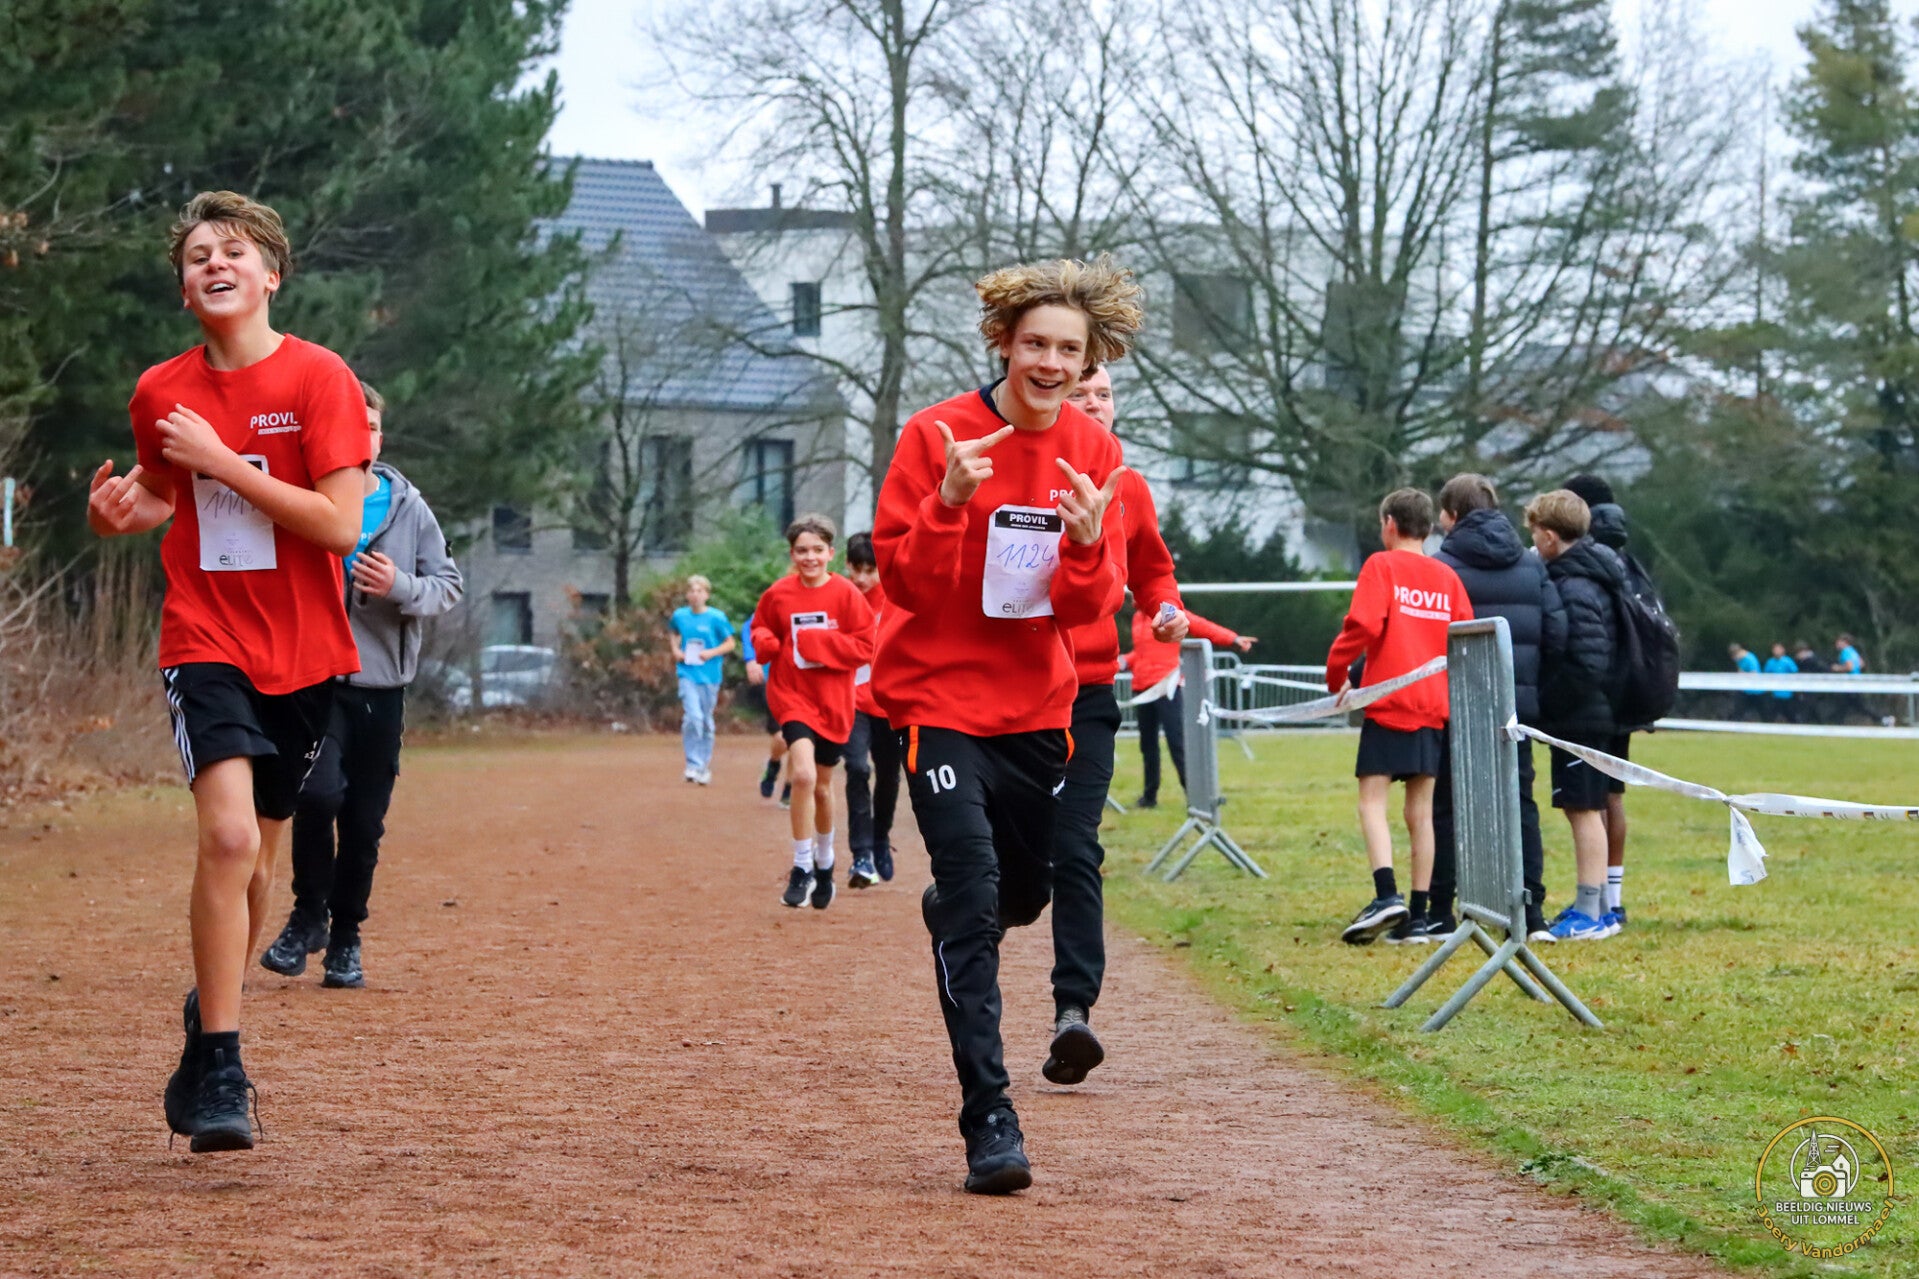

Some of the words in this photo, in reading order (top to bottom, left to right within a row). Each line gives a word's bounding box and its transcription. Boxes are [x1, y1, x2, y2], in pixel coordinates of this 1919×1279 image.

[203, 488, 260, 519] 111
[1009, 513, 1048, 525] PROVIL
[997, 543, 1055, 569] 1124
[1393, 585, 1451, 611] PROVIL
[926, 764, 957, 794] 10
